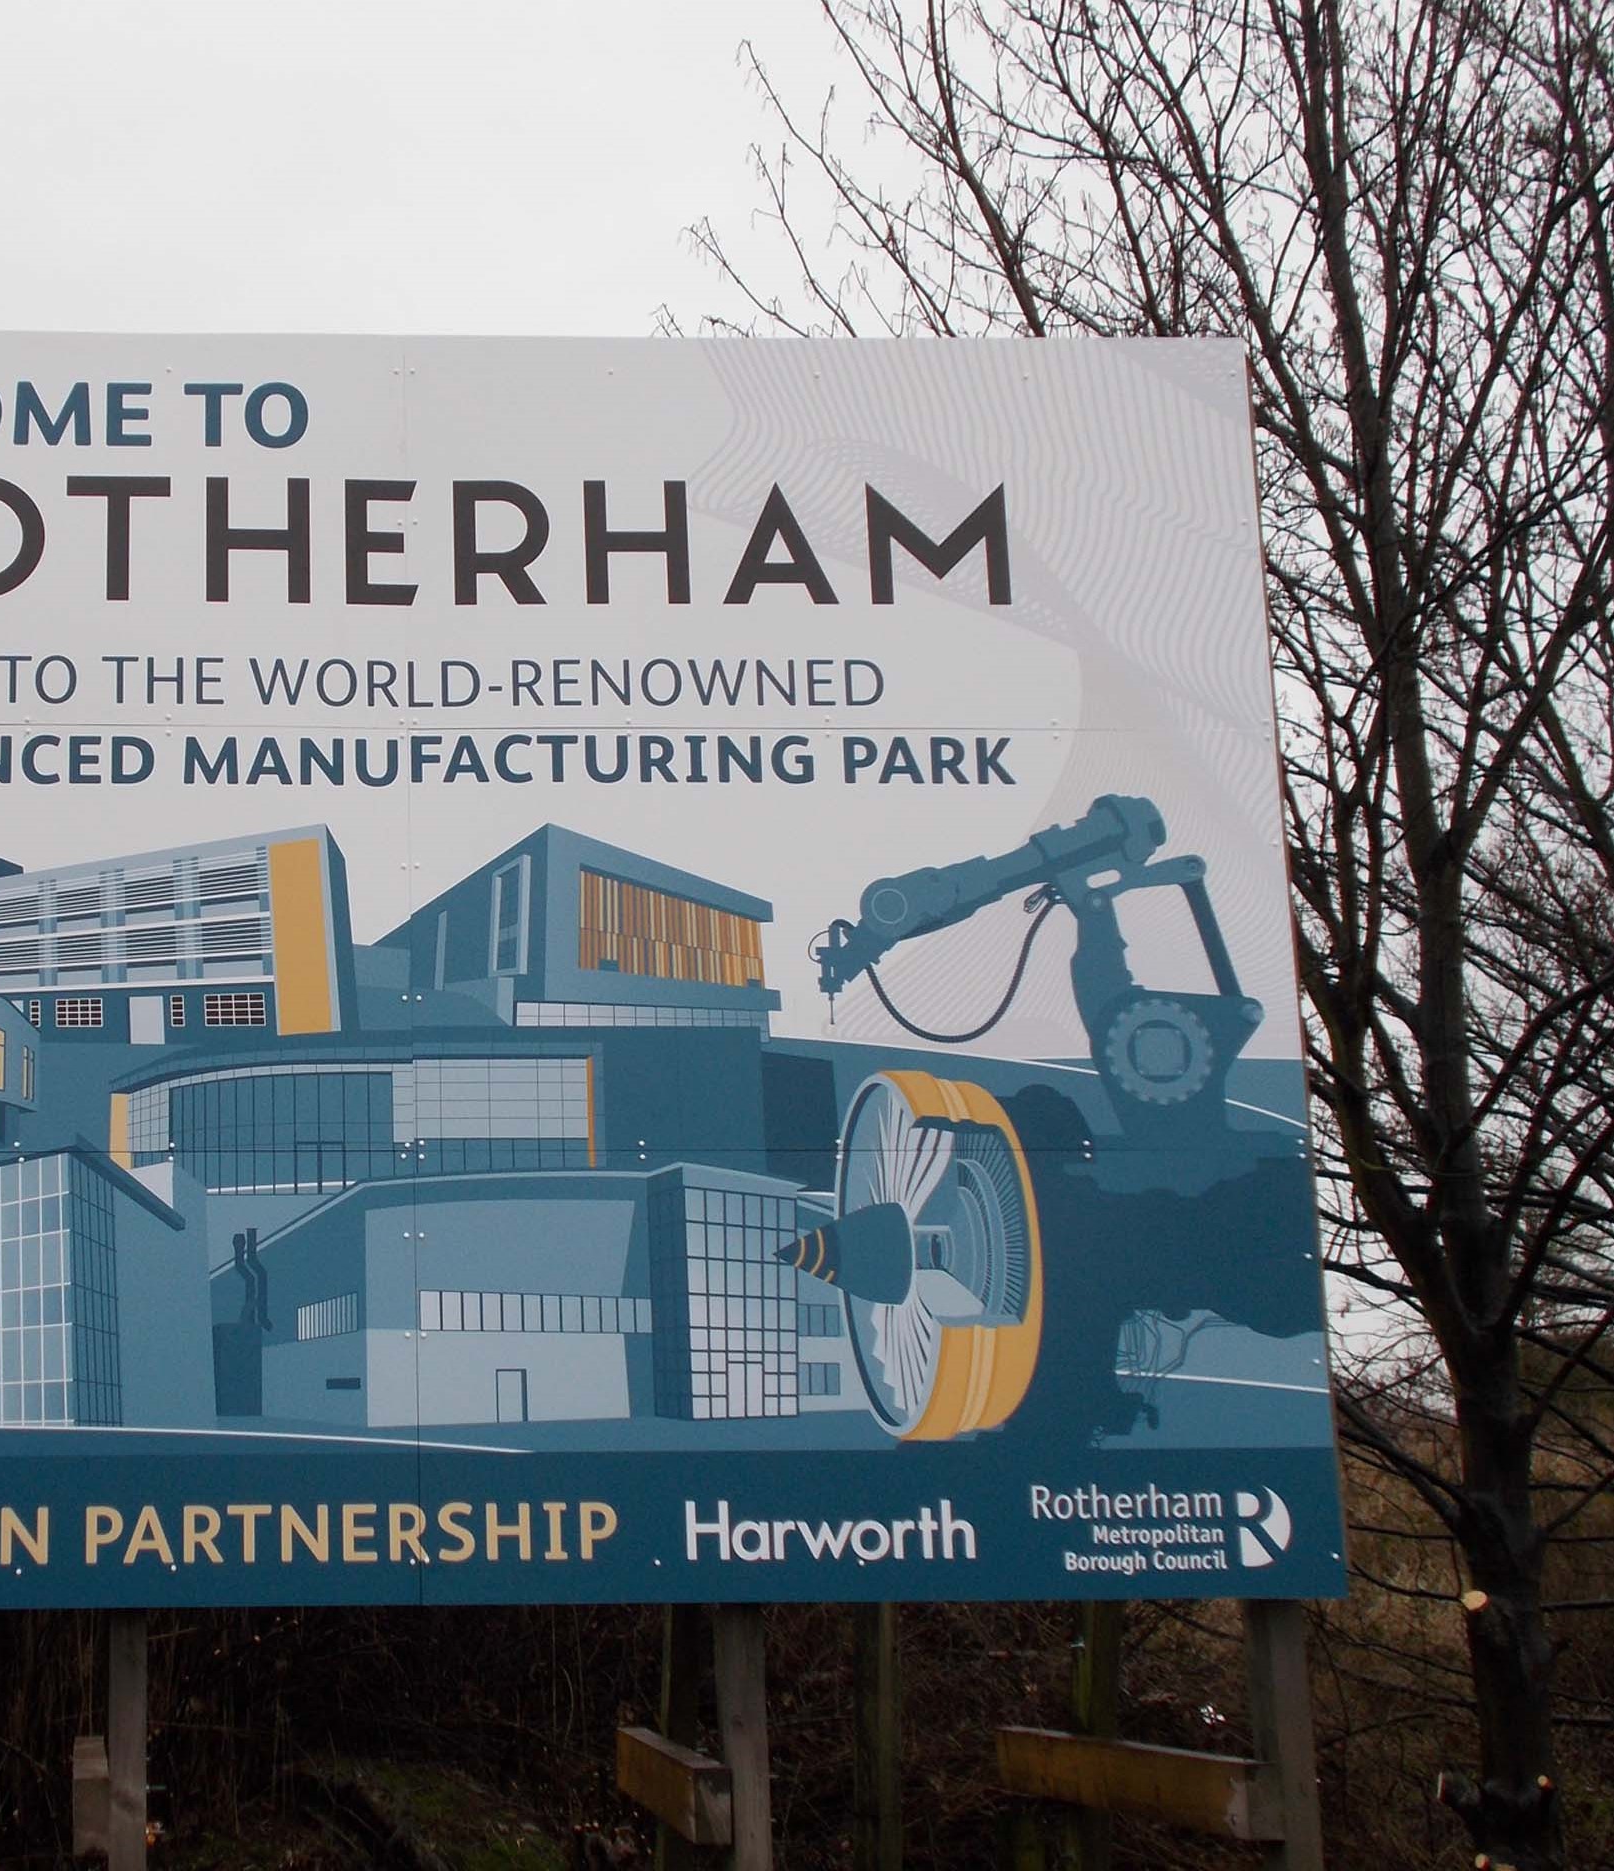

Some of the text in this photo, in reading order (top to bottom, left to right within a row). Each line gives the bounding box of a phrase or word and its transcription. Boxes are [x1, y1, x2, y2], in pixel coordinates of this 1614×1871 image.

[183, 382, 310, 449] TO
[101, 656, 226, 706] THE
[248, 656, 885, 708] WORLD-RENOWNED
[182, 733, 816, 787] MANUFACTURING
[841, 736, 1018, 786] PARK
[1030, 1483, 1223, 1520] Rotherham
[84, 1501, 619, 1565] PARTNERSHIP
[684, 1499, 977, 1562] Harworth
[1091, 1523, 1225, 1548] Metropolitan
[1063, 1549, 1229, 1576] Borough Council
